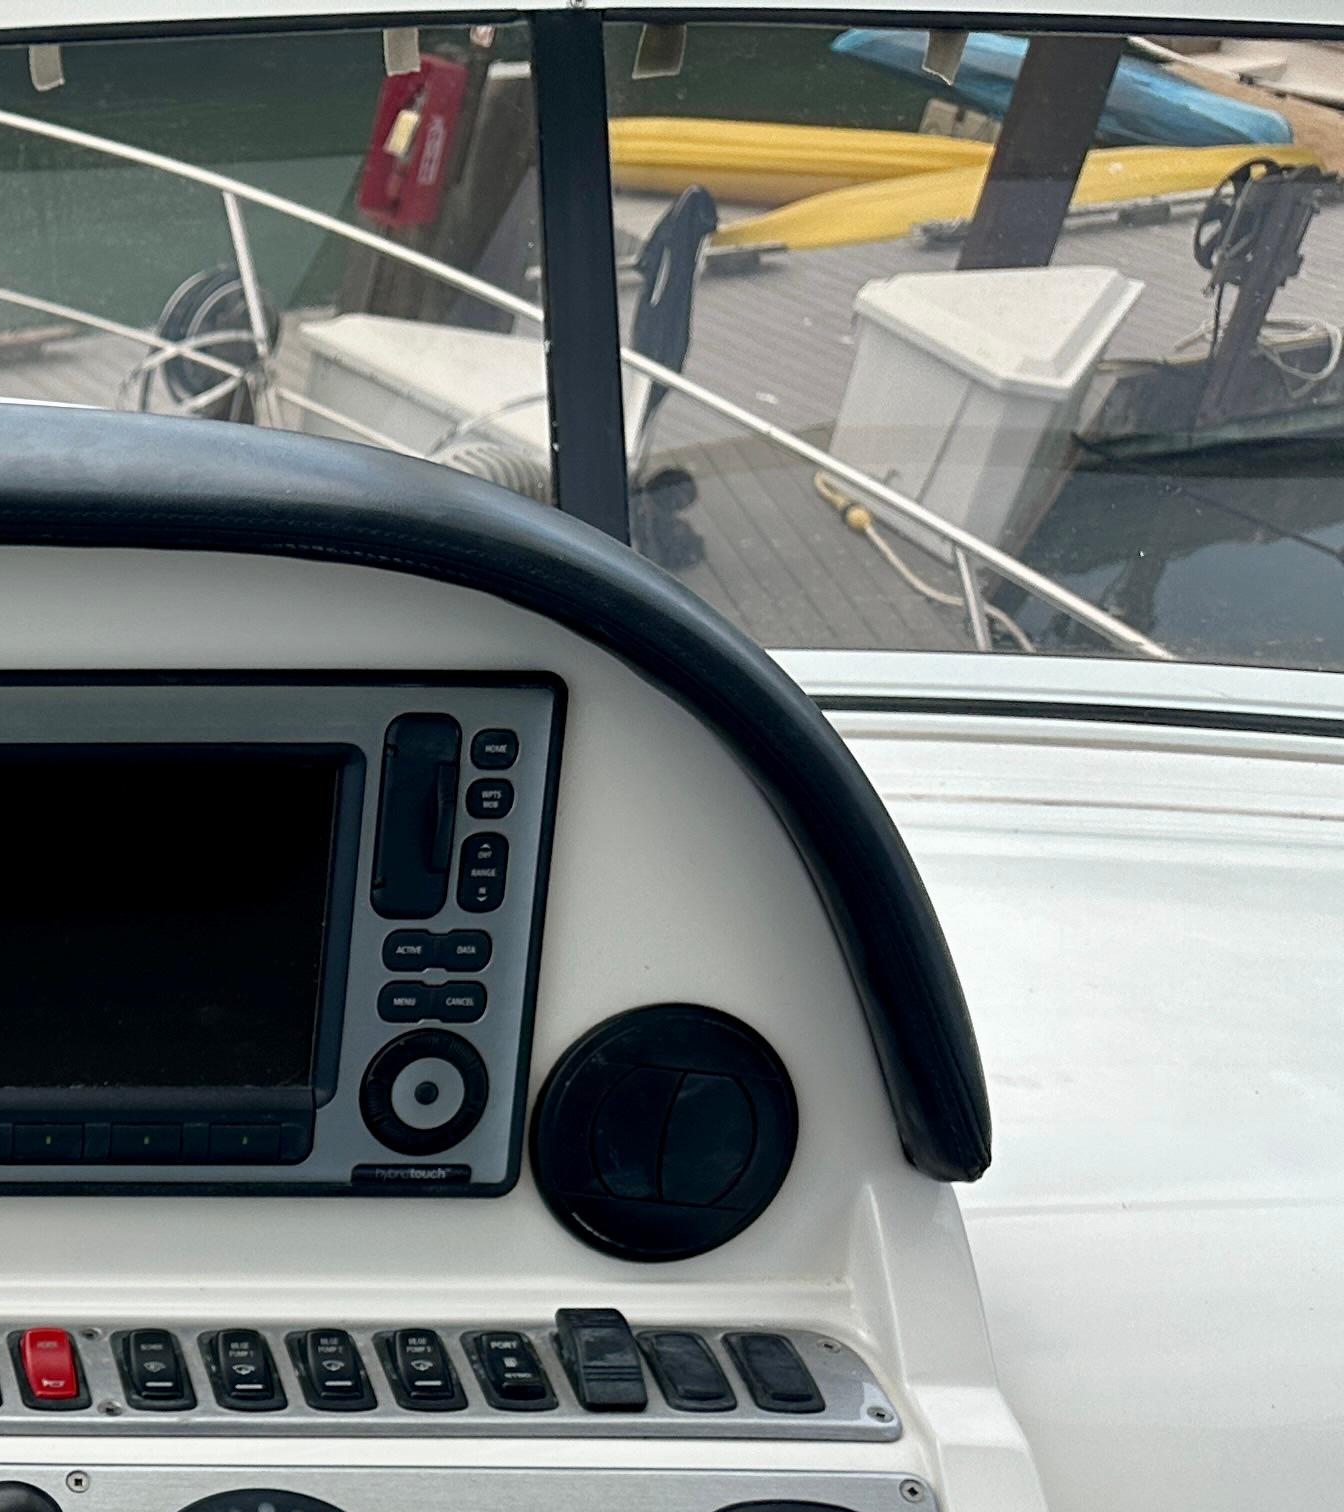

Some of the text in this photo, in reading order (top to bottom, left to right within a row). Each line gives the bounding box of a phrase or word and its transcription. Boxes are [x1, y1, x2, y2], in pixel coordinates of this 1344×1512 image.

[485, 744, 507, 753] HOME
[395, 946, 422, 955] ACTIVE
[393, 997, 416, 1007] MENU
[445, 997, 474, 1007] CANCEL
